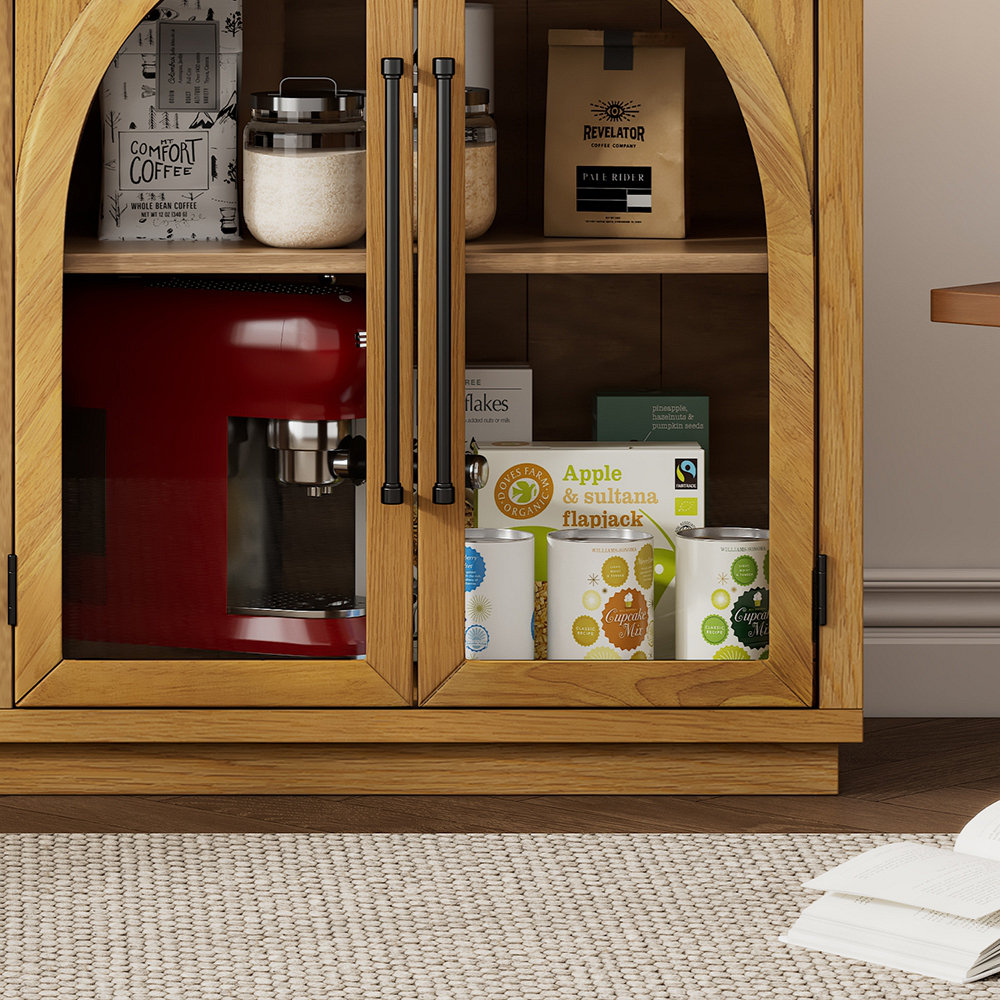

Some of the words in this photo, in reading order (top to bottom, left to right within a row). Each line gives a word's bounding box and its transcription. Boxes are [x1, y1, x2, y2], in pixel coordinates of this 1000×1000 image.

[583, 125, 645, 142] REVELATOR
[131, 138, 203, 165] COMFORT
[130, 156, 193, 184] COFFEE
[612, 172, 645, 182] RIDER
[131, 202, 153, 210] WHOLE
[155, 202, 172, 210] BEAN
[174, 202, 198, 210] COFFEE
[652, 405, 689, 413] pineapple,
[652, 413, 687, 421] hazelnuts
[688, 413, 695, 421] &
[652, 421, 683, 430] pumpkin
[684, 421, 704, 430] seeds
[497, 467, 522, 501] DOVES
[524, 466, 550, 488] FARM
[562, 464, 622, 486] Apple
[503, 491, 550, 517] ORGANIC
[562, 488, 578, 504] &
[583, 487, 658, 505] sultana
[562, 510, 643, 529] flapjack
[604, 608, 647, 626] Cupcake
[619, 622, 644, 638] Mix
